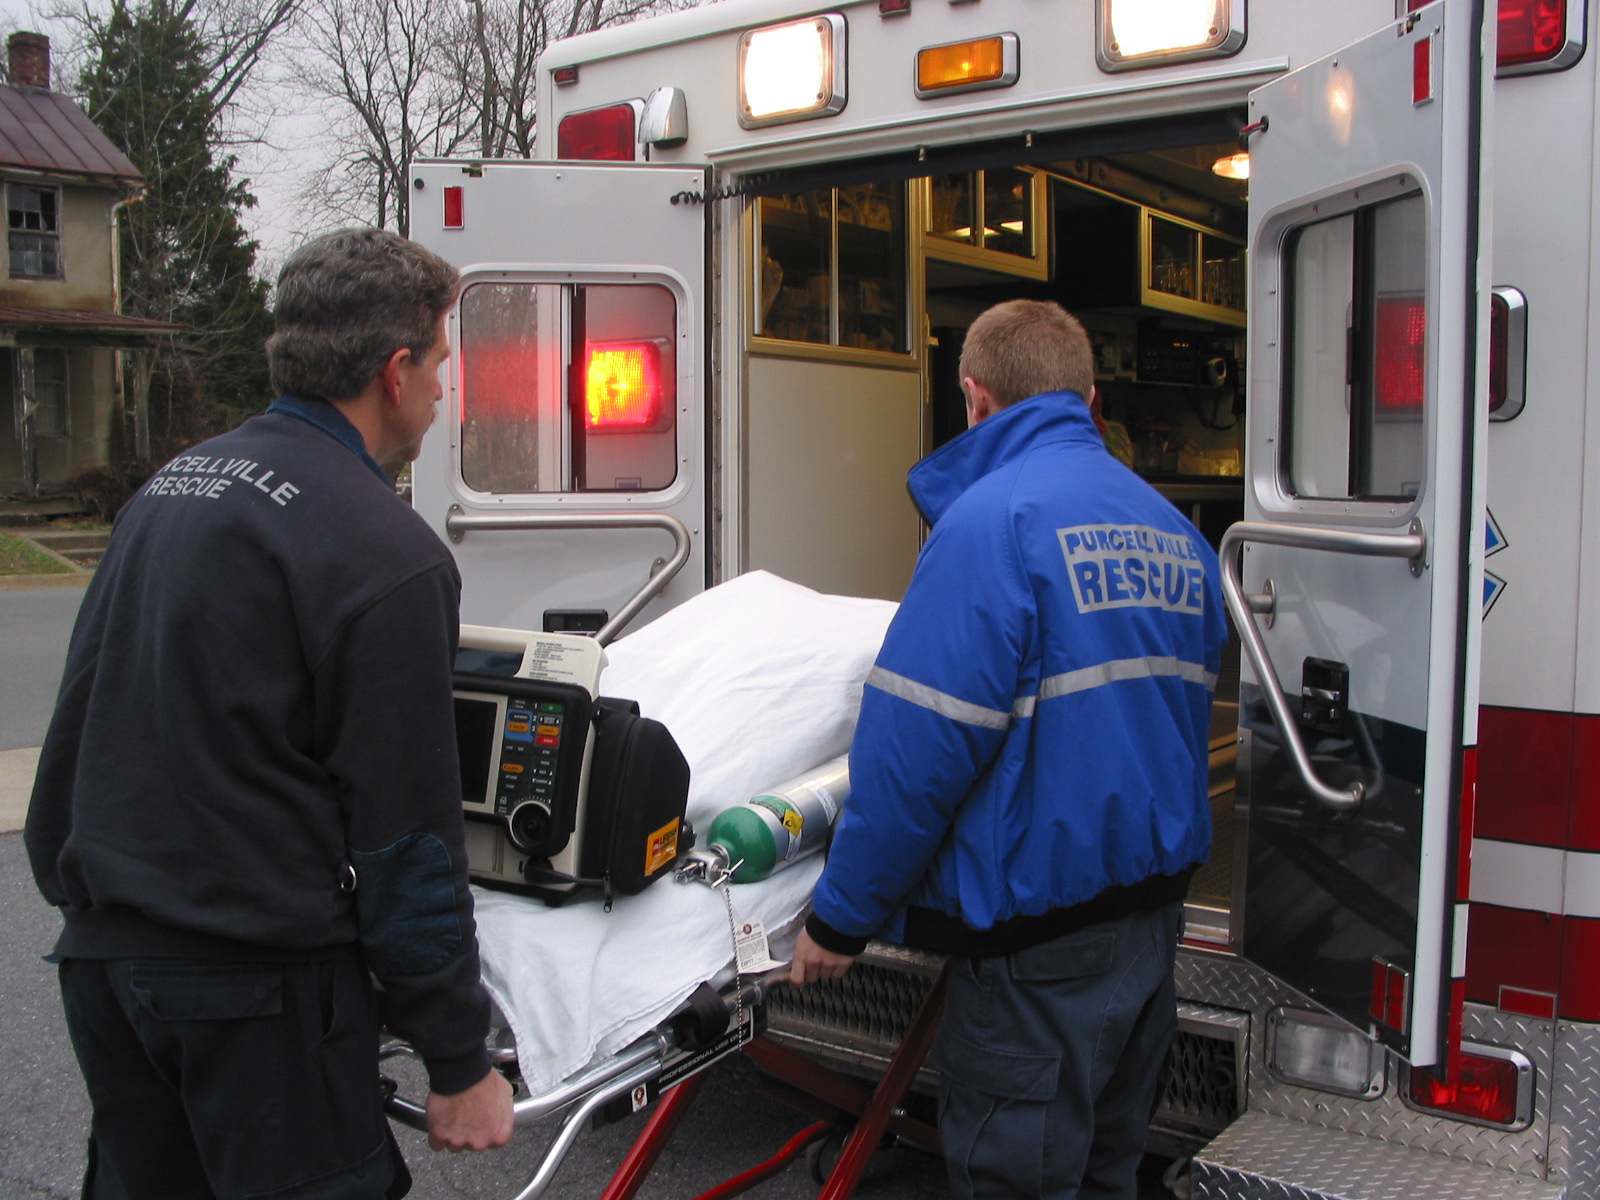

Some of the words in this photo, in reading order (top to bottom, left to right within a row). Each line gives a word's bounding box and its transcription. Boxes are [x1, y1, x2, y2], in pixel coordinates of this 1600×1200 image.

[144, 477, 232, 498] RESCUE
[1064, 529, 1200, 560] PURCELLVILLE
[1073, 558, 1203, 607] RESCUE
[659, 1049, 713, 1083] PROFESSIONAL
[715, 1040, 728, 1051] USE
